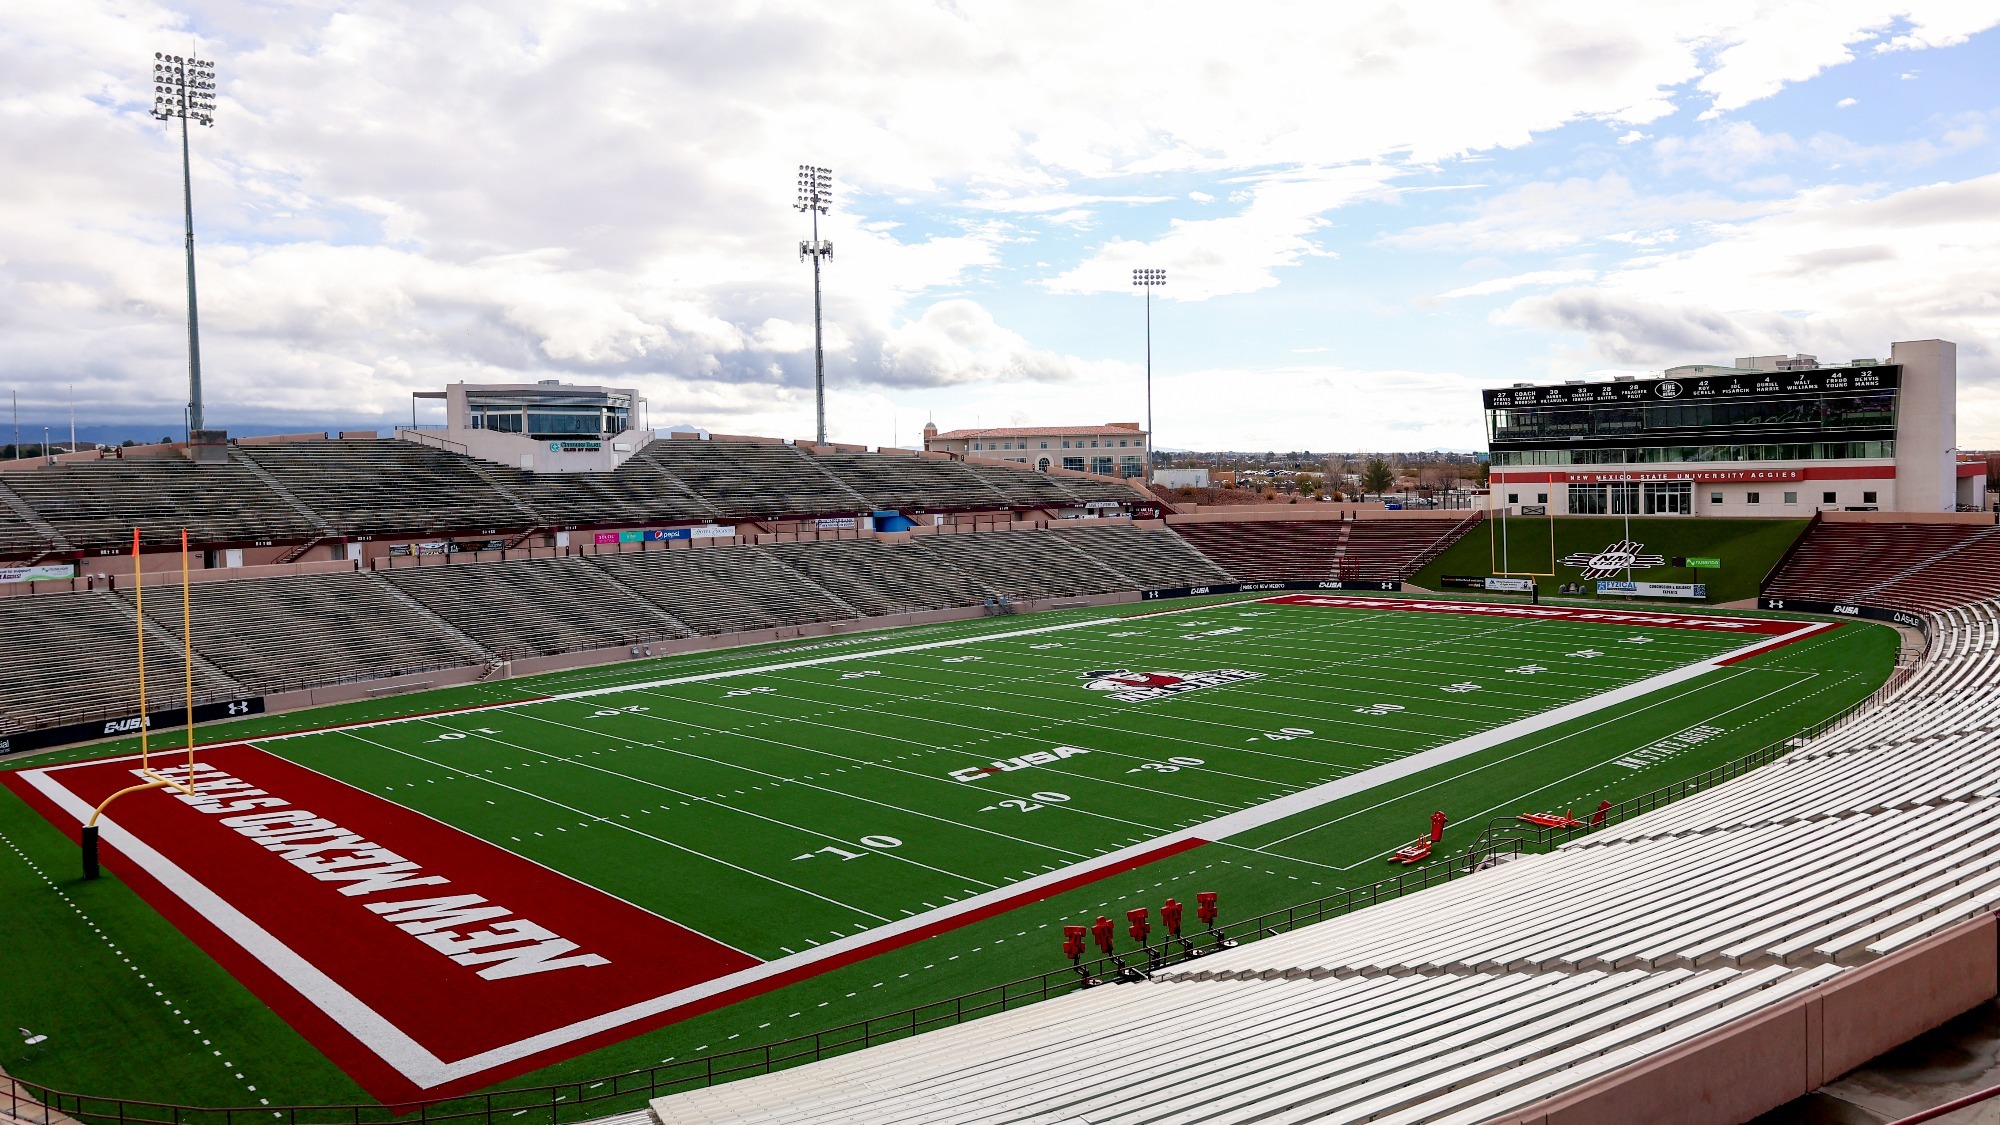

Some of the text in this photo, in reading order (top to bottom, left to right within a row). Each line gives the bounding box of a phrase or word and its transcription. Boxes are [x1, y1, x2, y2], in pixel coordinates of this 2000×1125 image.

[663, 530, 680, 538] pepsi
[1264, 727, 1315, 741] 40
[1141, 756, 1206, 774] 30
[998, 791, 1072, 813] 20
[815, 835, 903, 862] 10
[128, 762, 612, 982] NEW MEXICO STATE
